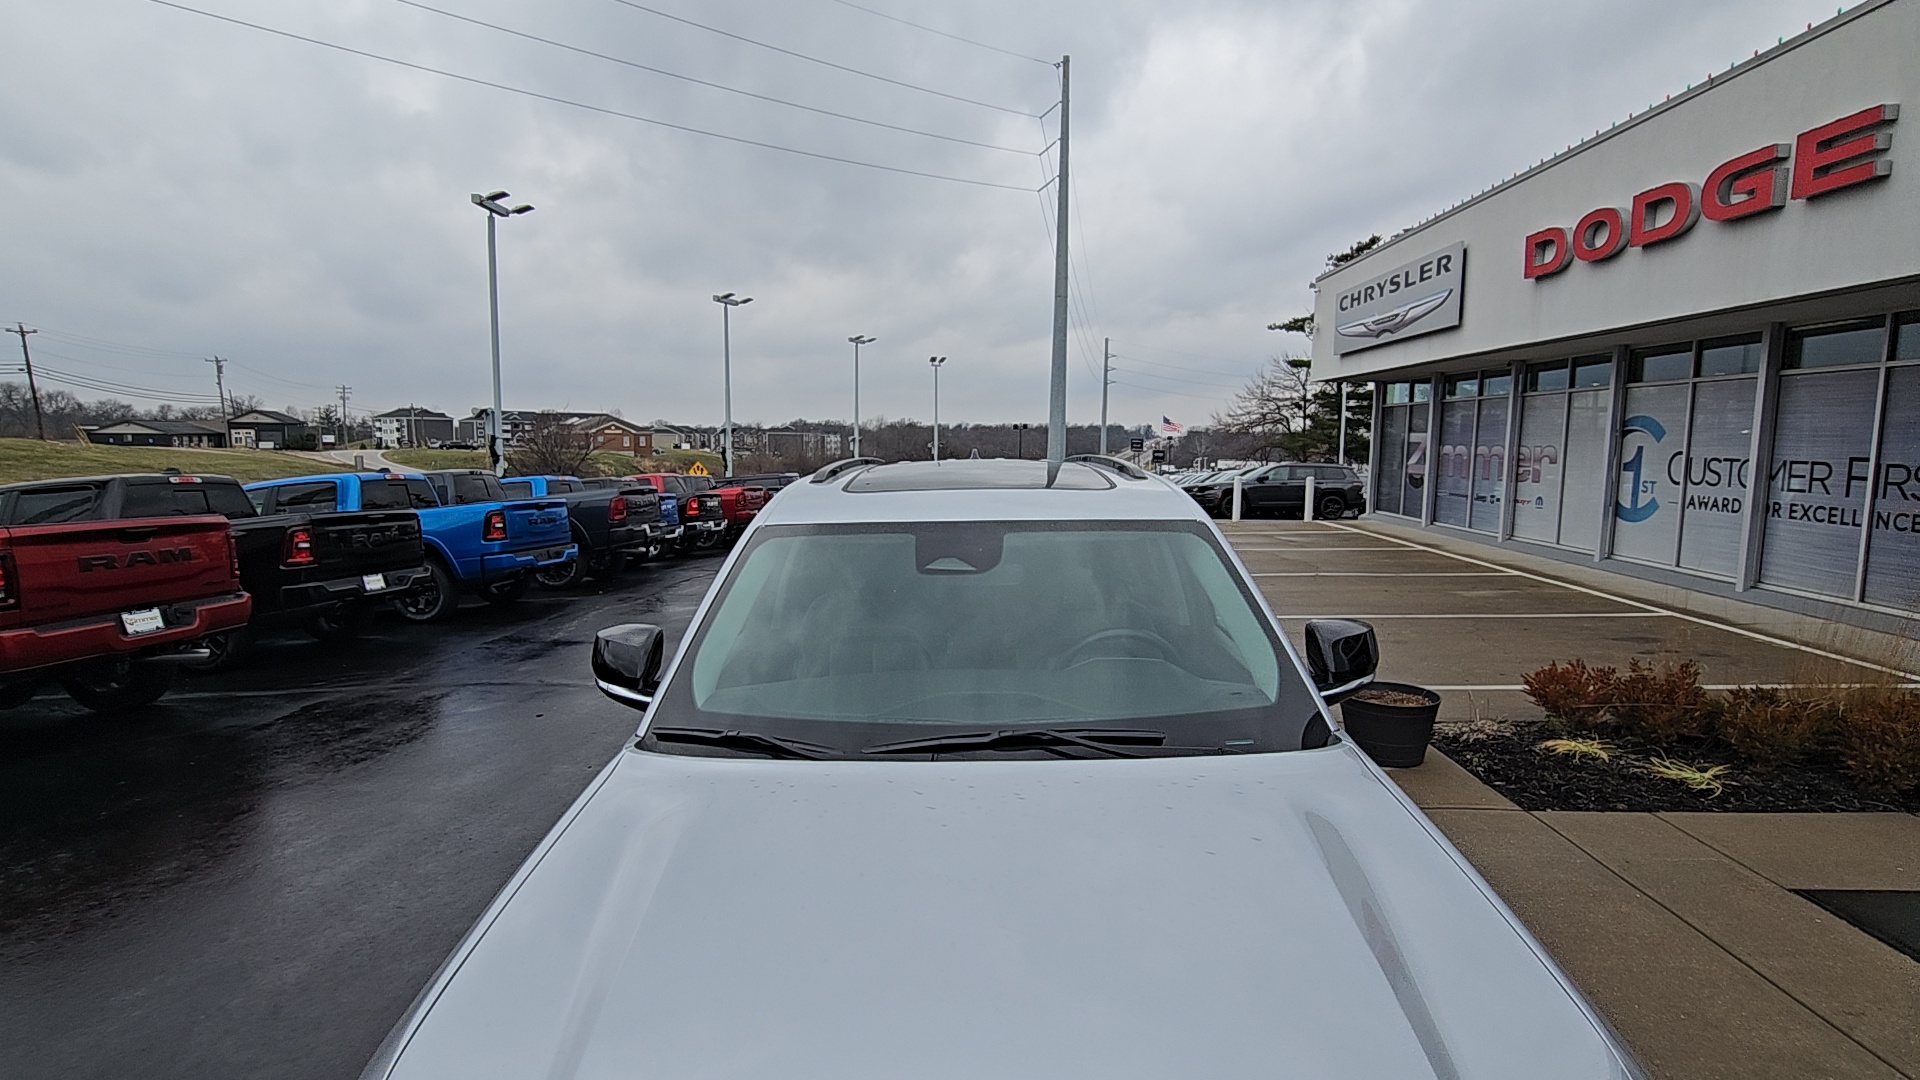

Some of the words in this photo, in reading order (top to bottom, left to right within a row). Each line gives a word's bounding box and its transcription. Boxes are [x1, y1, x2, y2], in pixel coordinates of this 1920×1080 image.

[1524, 102, 1899, 280] DODGE
[1339, 254, 1453, 312] CHRYSLER
[1407, 432, 1558, 485] Zmmer
[528, 515, 556, 526] RAM
[1686, 494, 1742, 514] AWARD
[1788, 502, 1920, 534] EXCELLNCE
[352, 531, 399, 547] RAM
[78, 546, 194, 573] RAM
